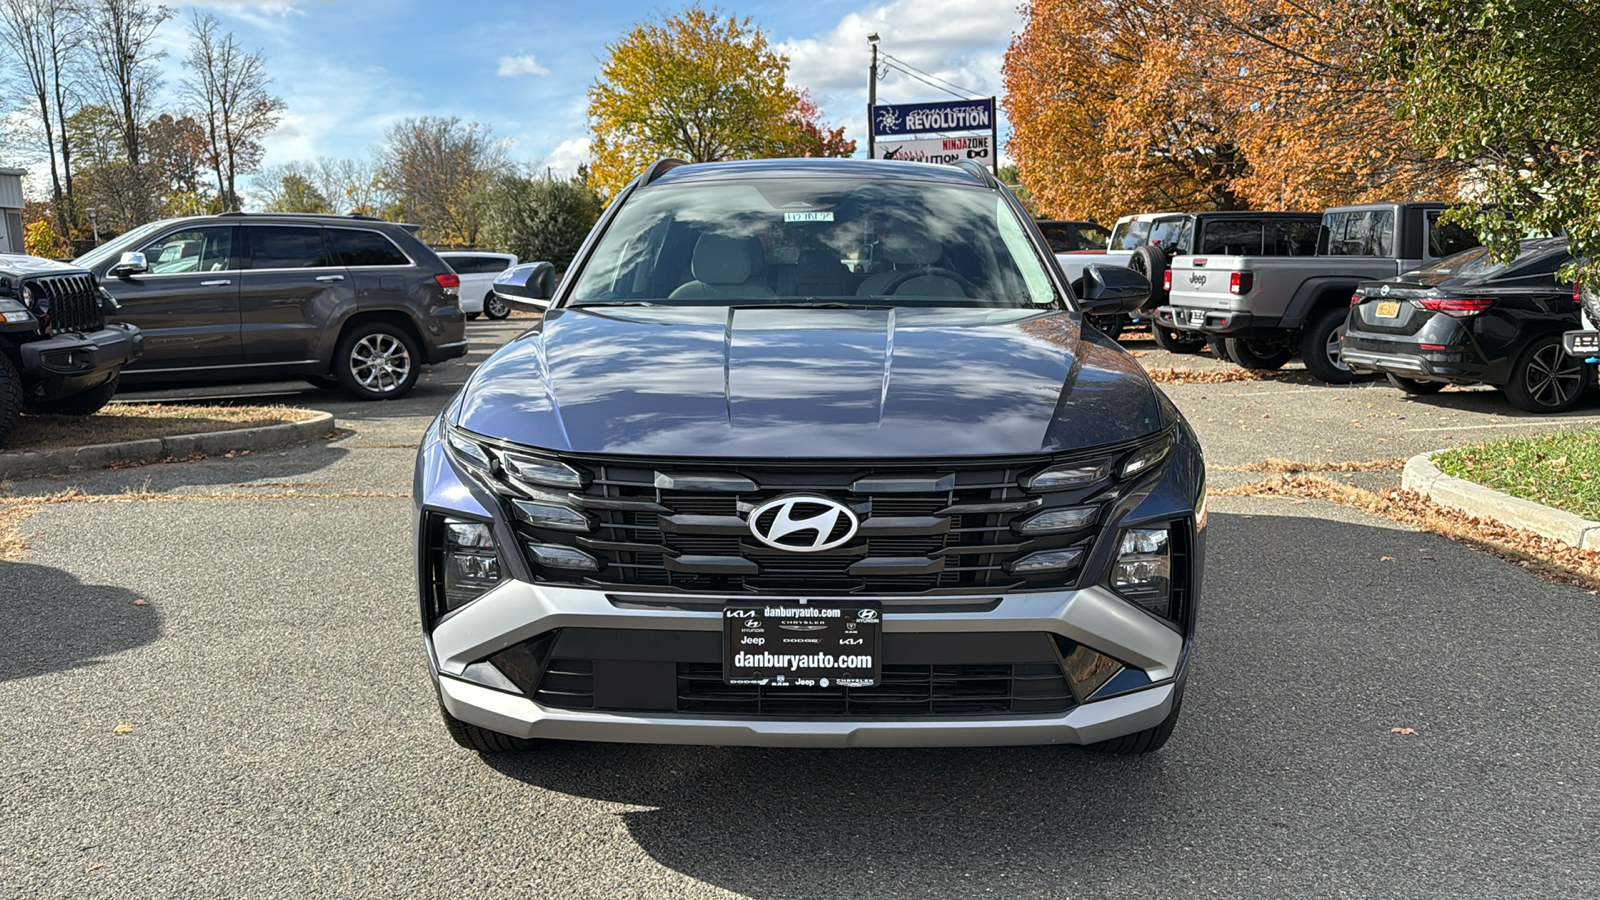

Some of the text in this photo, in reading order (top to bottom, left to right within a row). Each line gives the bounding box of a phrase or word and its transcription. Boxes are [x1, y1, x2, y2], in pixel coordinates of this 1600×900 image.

[909, 106, 984, 118] GYMNASTICS
[906, 111, 988, 130] REVOLUTION
[1190, 272, 1206, 286] Jeep
[764, 605, 841, 619] danburyauto.com
[741, 636, 765, 645] Jeep
[734, 651, 872, 672] danburyauto.com
[795, 678, 815, 687] Jeep
